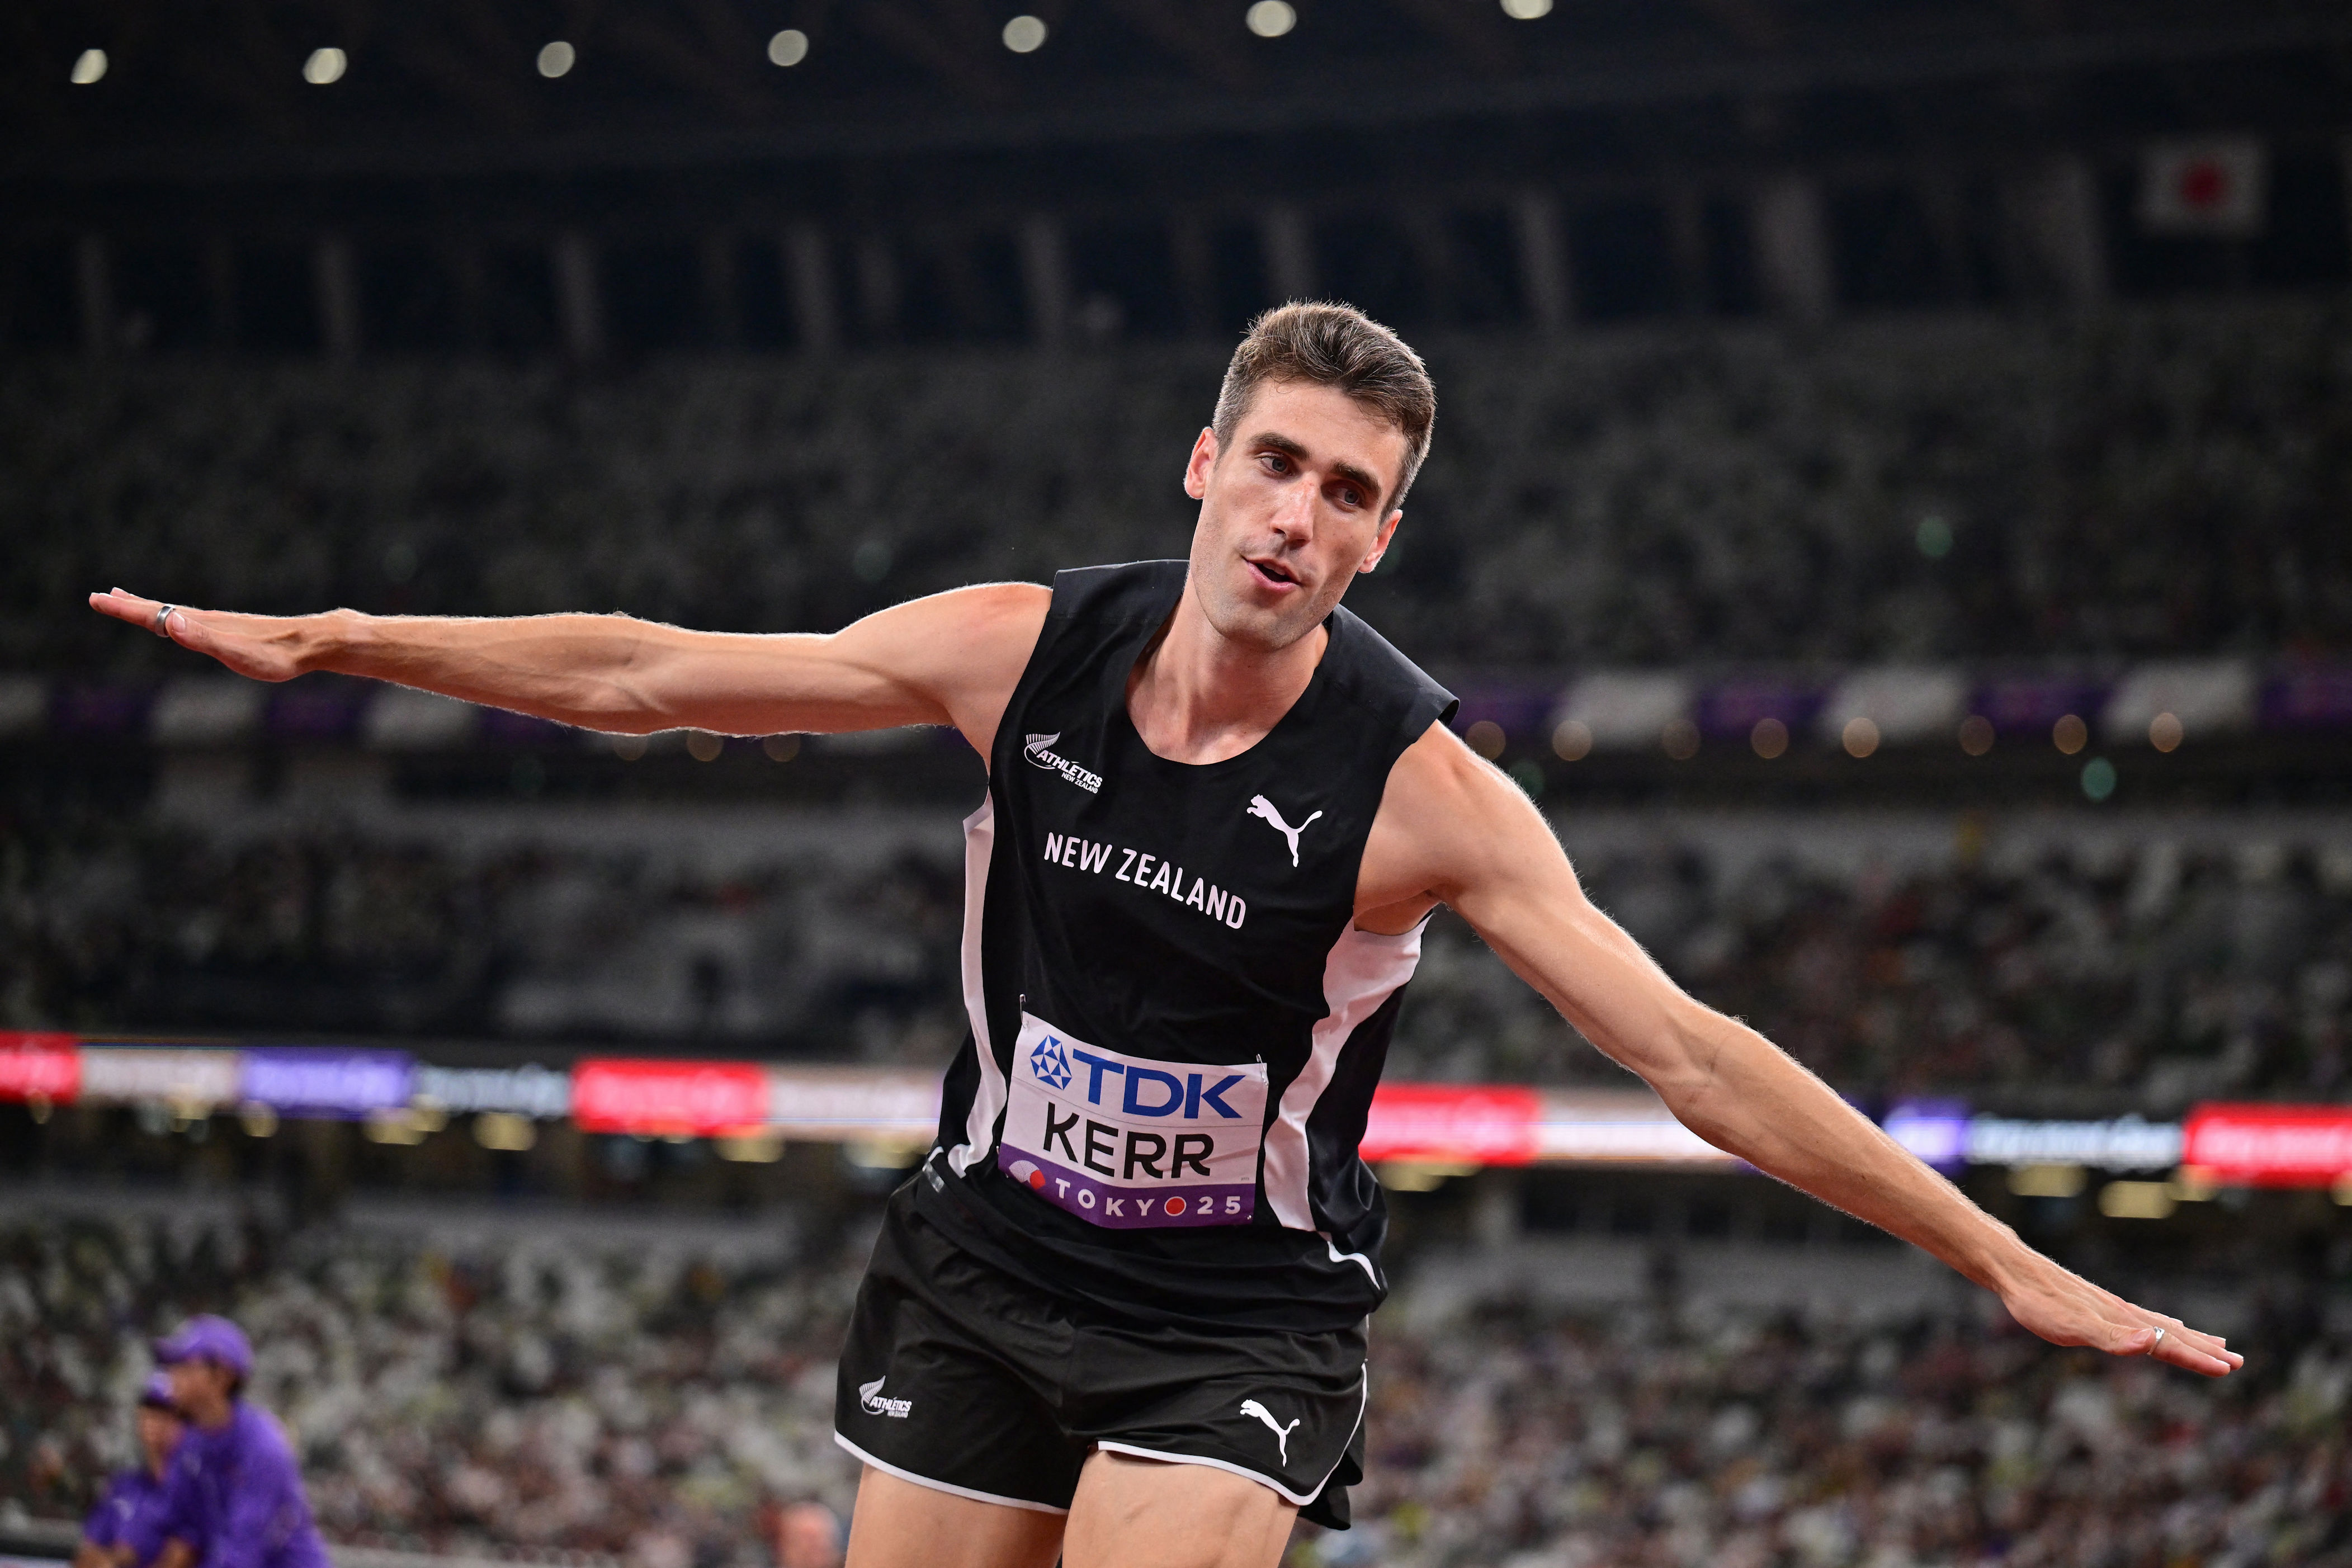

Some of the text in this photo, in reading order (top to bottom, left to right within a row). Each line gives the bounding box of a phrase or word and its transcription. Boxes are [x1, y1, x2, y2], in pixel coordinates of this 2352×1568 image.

[1036, 749, 1103, 788] ATHLETICS
[1061, 772, 1098, 794] NEW ZEALAND
[1044, 832, 1246, 929] NEW ZEALAND
[1073, 1048, 1246, 1119] TDK
[1043, 1101, 1215, 1180] KERR
[869, 1395, 913, 1412] ATHLETICS
